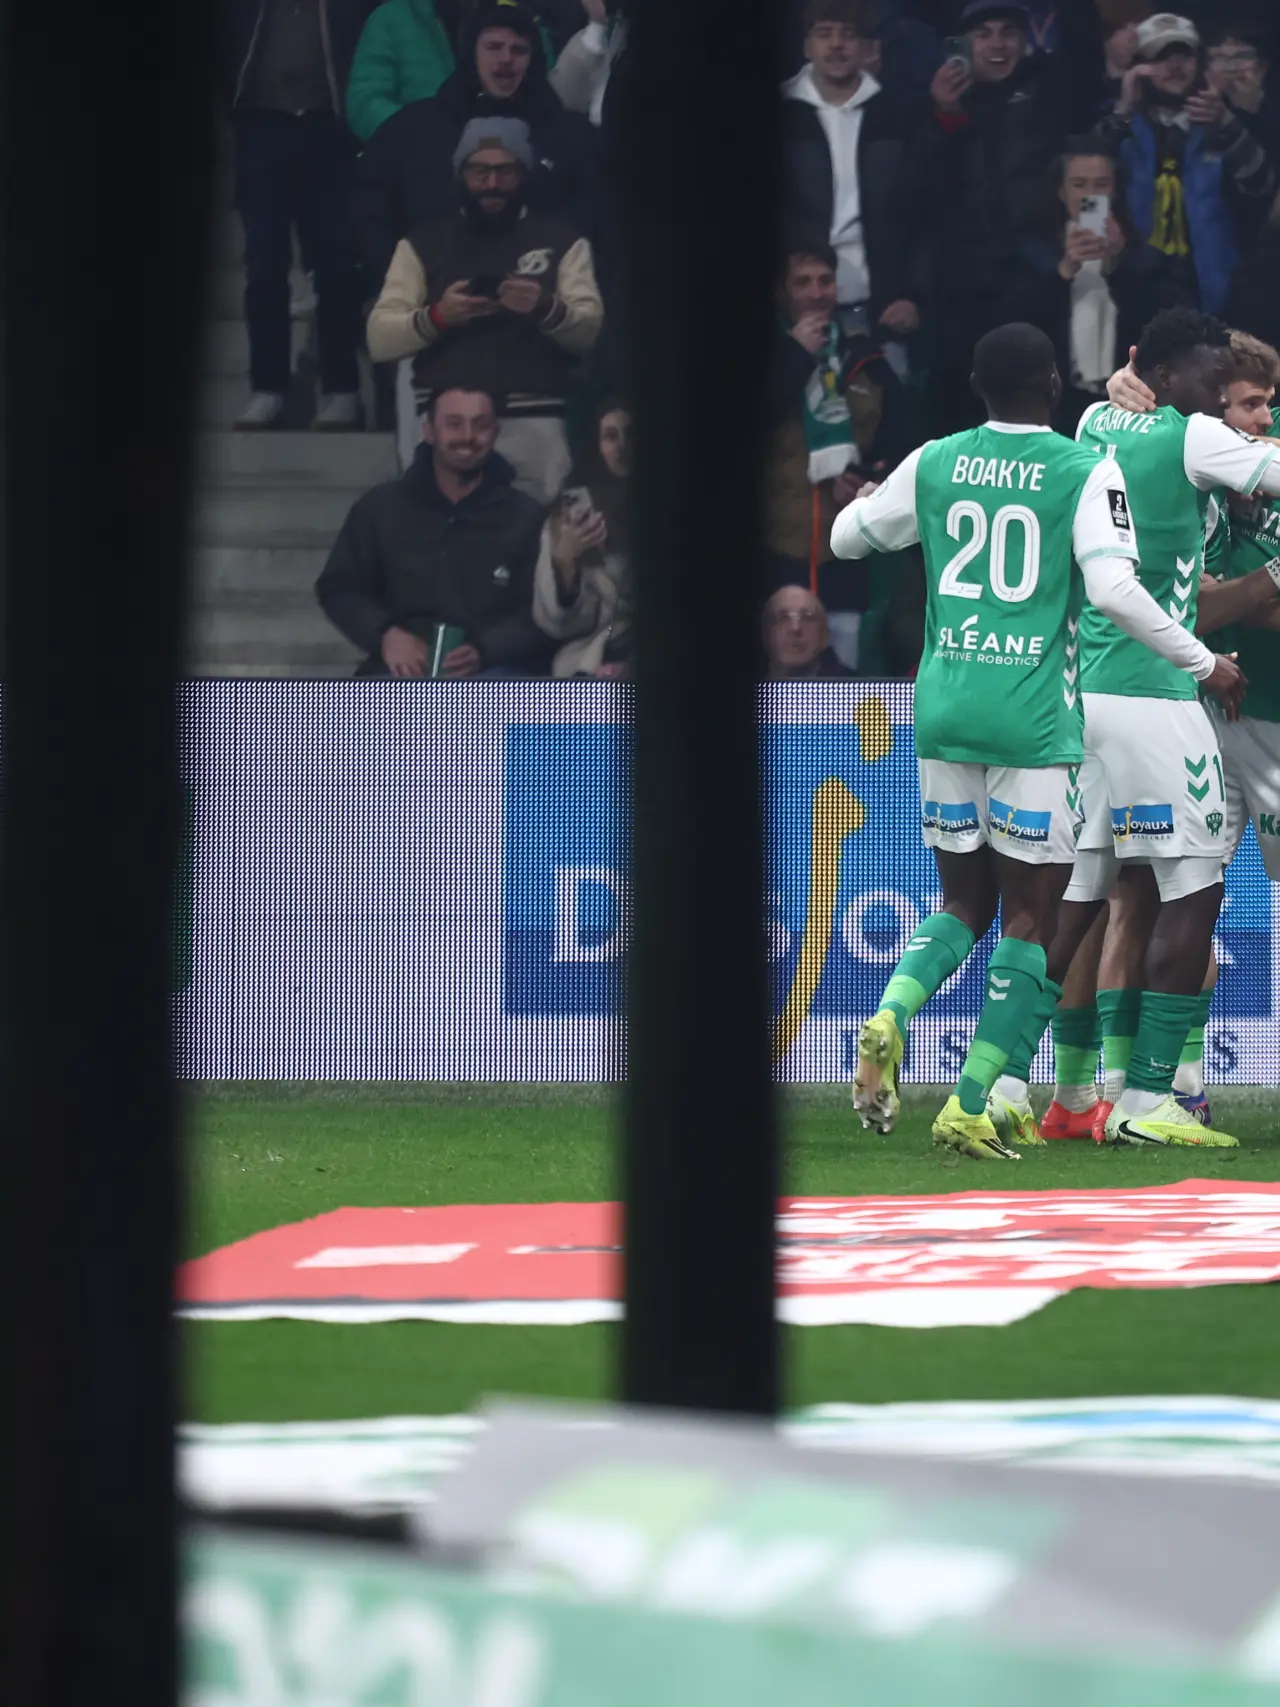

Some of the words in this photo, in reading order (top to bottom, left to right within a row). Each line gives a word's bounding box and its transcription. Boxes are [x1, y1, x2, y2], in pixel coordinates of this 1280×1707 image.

[951, 455, 1046, 491] BOAKYE
[938, 499, 1041, 603] 20
[976, 653, 1040, 667] ROBOTICS
